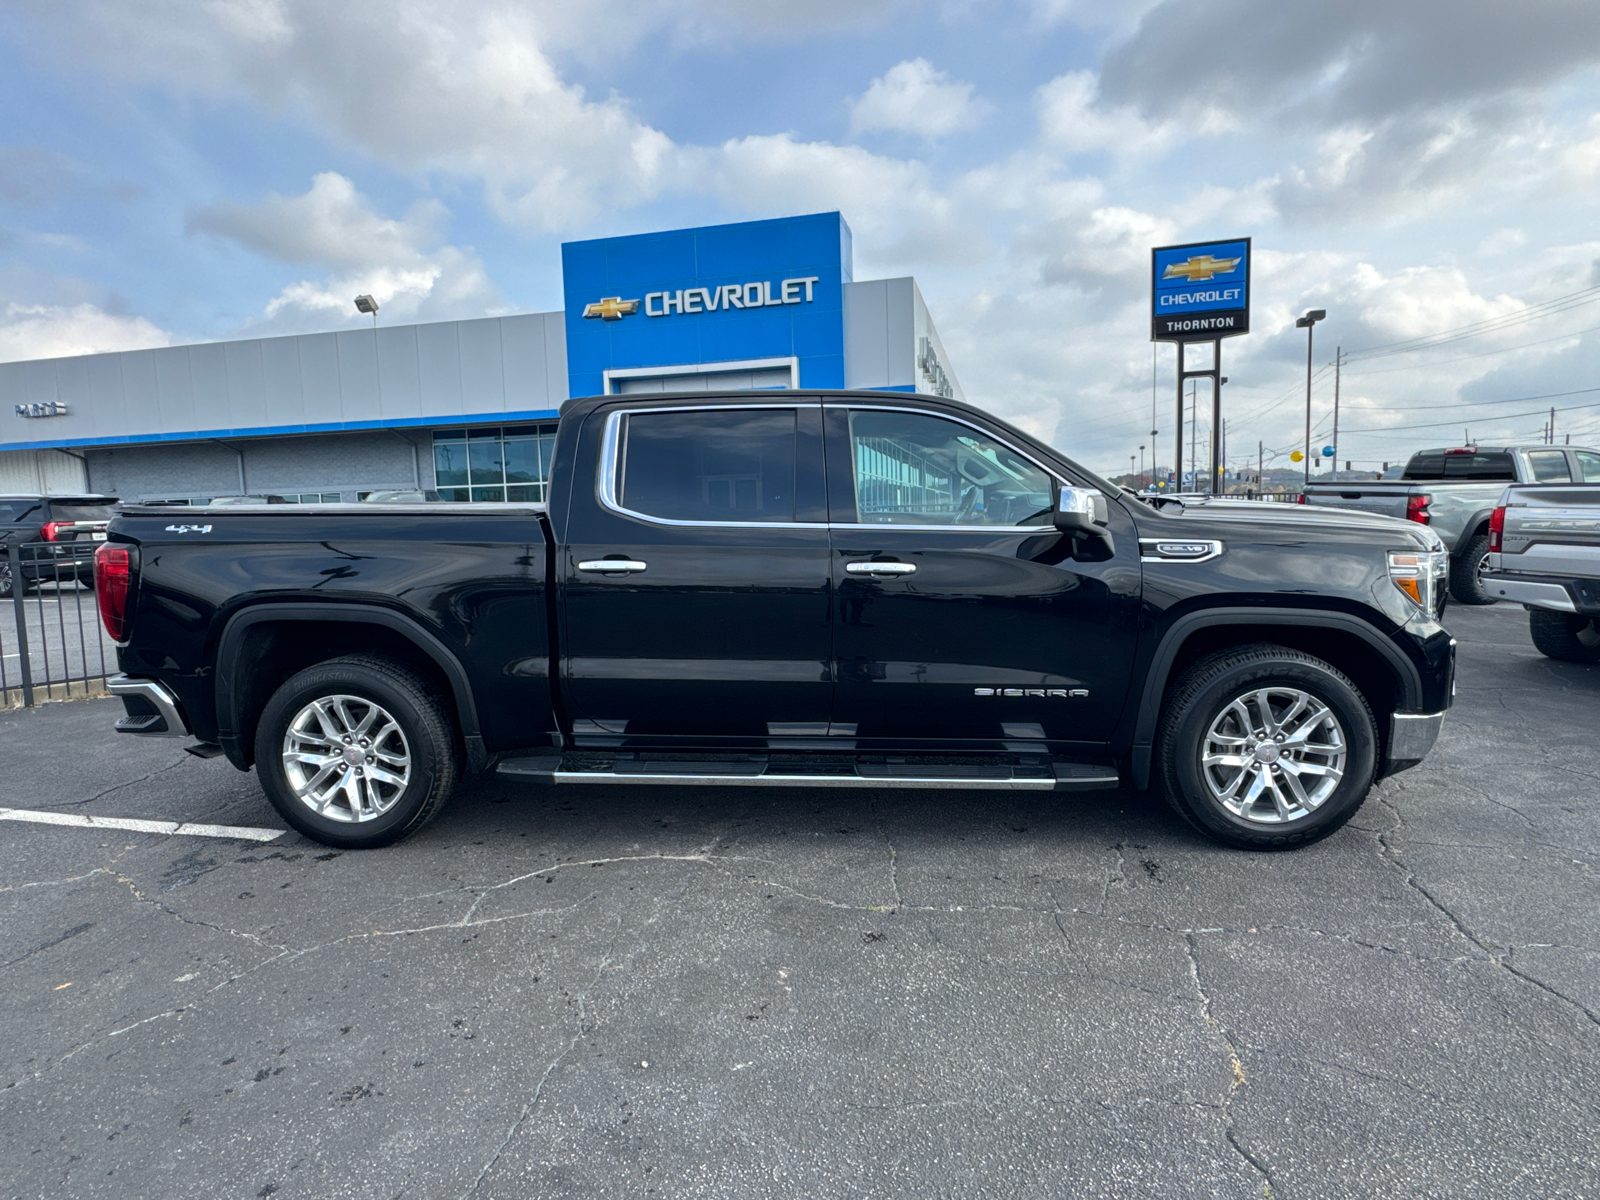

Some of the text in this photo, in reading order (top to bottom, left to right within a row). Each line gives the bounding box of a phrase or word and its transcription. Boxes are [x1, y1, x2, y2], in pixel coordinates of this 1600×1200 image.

[645, 276, 819, 318] CHEVROLET
[1160, 289, 1241, 306] CHEVROLET
[1166, 317, 1234, 332] THORNTON
[15, 401, 67, 417] PARTS
[974, 687, 1089, 698] SIERRA
